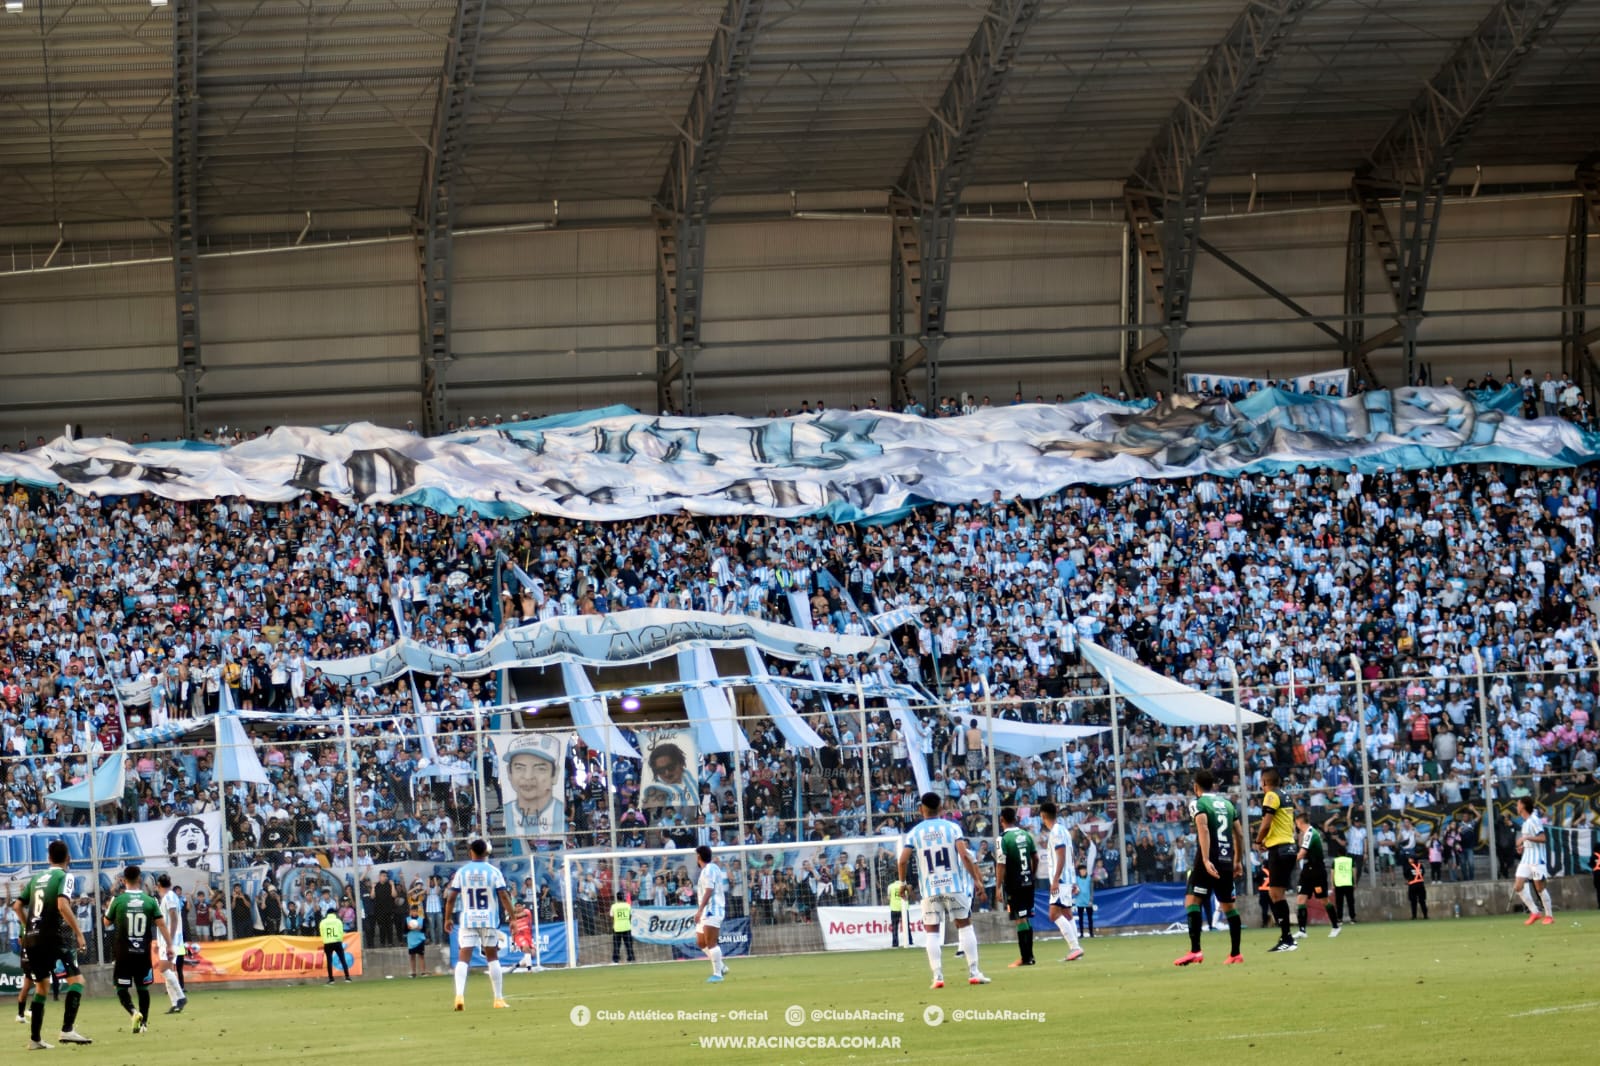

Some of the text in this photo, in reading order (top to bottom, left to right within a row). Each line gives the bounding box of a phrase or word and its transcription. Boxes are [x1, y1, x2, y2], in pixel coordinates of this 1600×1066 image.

[1217, 815, 1228, 842] 2
[923, 847, 951, 874] 14
[1019, 848, 1028, 870] 5
[34, 889, 44, 917] 6
[467, 888, 489, 910] 16
[126, 912, 147, 937] 10
[326, 927, 338, 938] RL
[829, 920, 926, 935] Merthilat
[718, 934, 748, 943] SAN LUIS
